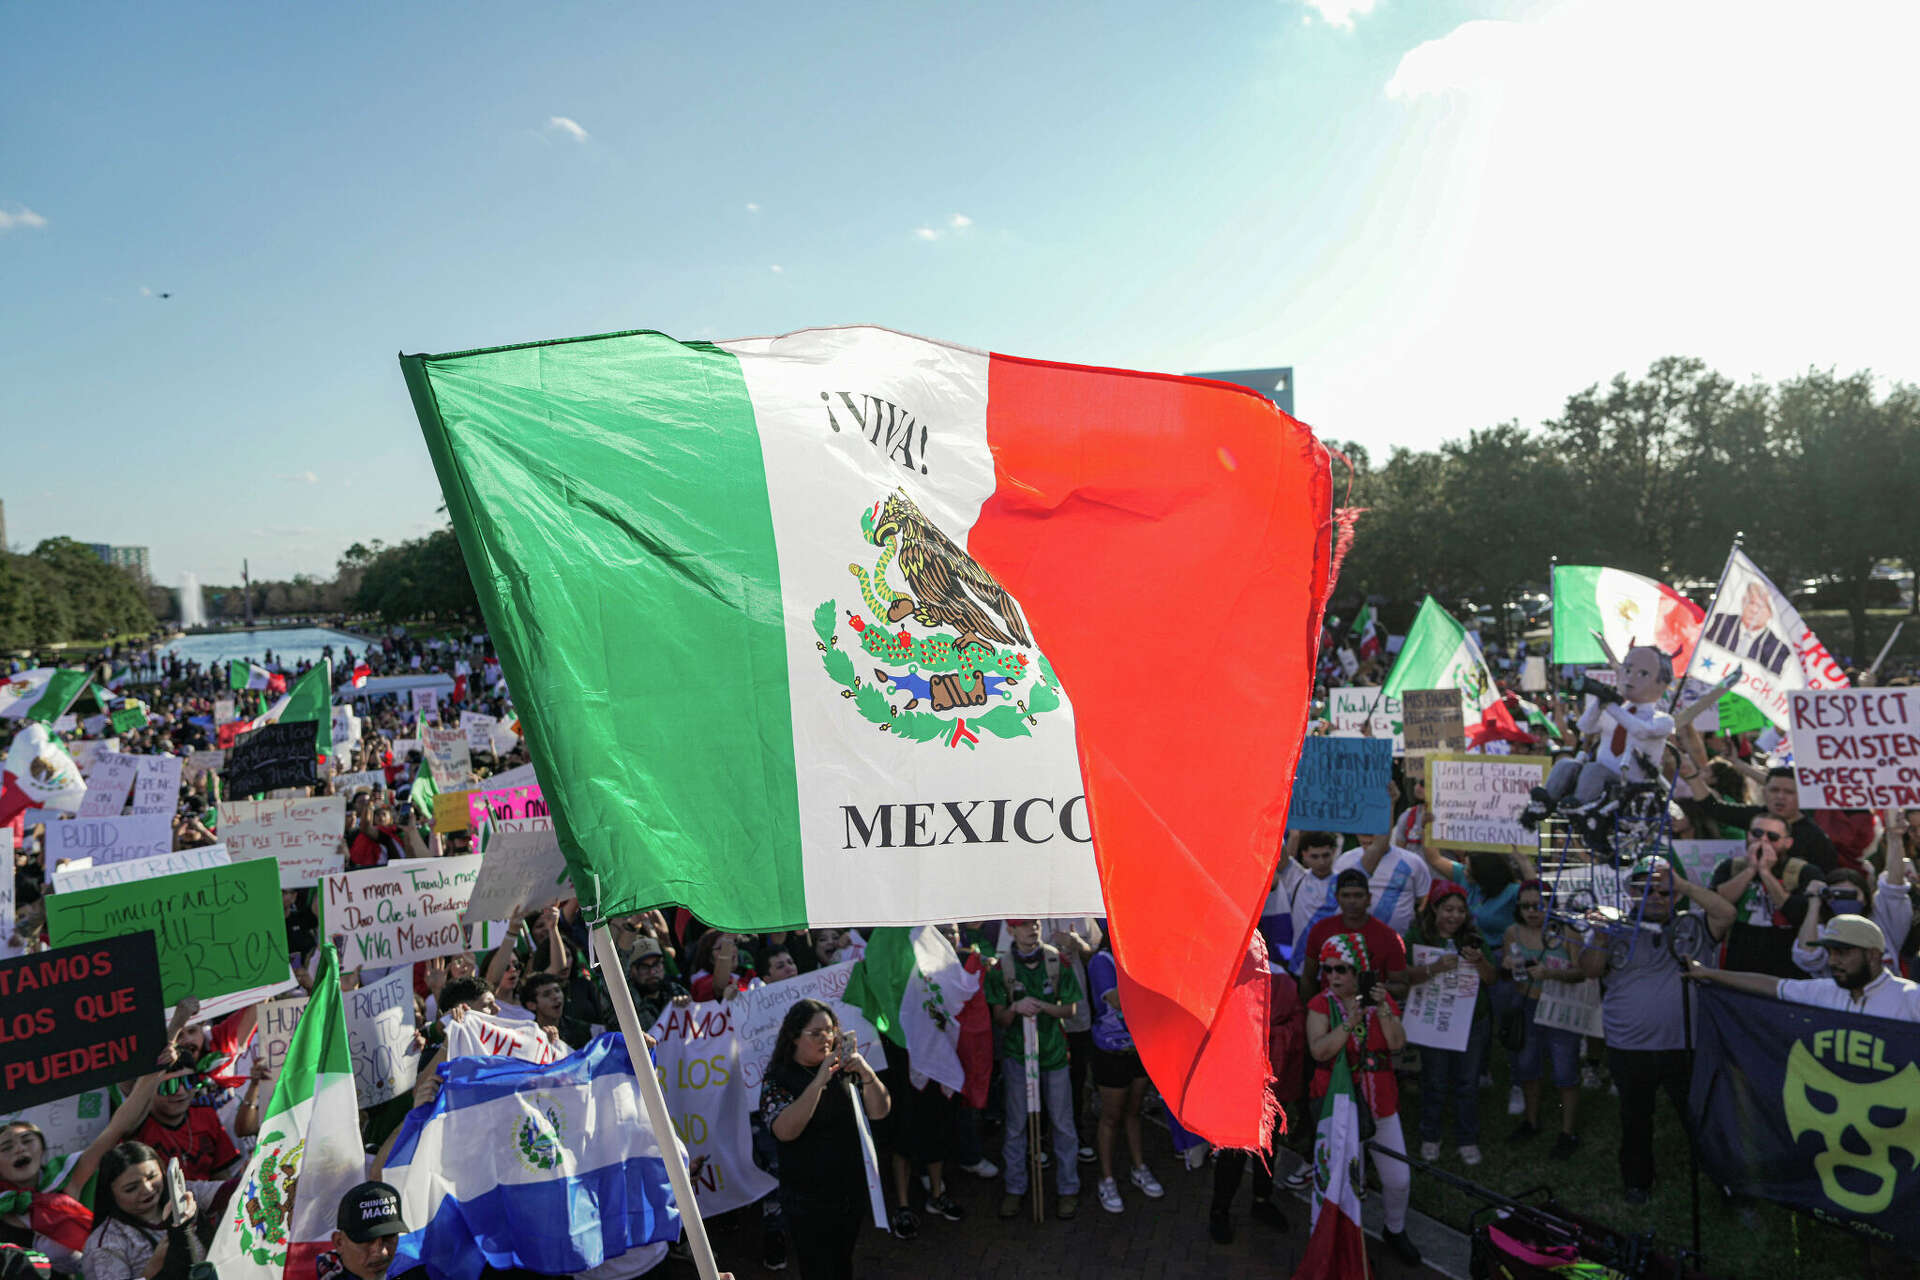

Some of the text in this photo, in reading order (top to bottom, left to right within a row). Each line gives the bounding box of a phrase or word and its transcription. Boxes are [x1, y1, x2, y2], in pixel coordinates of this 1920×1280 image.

[820, 391, 928, 475] ¡VIVA!
[1794, 693, 1908, 730] RESPECT
[1798, 767, 1877, 787] EXPECT
[525, 800, 550, 818] ON
[1823, 784, 1920, 808] RESISTA
[61, 822, 119, 849] BUILD
[839, 795, 1092, 849] MEXICO
[352, 979, 406, 1020] RIGHTS
[816, 966, 853, 1000] NO
[0, 987, 137, 1044] LOS QUE
[1813, 1028, 1896, 1074] FIEL
[678, 1054, 731, 1091] LOS
[361, 1204, 398, 1220] MAGA
